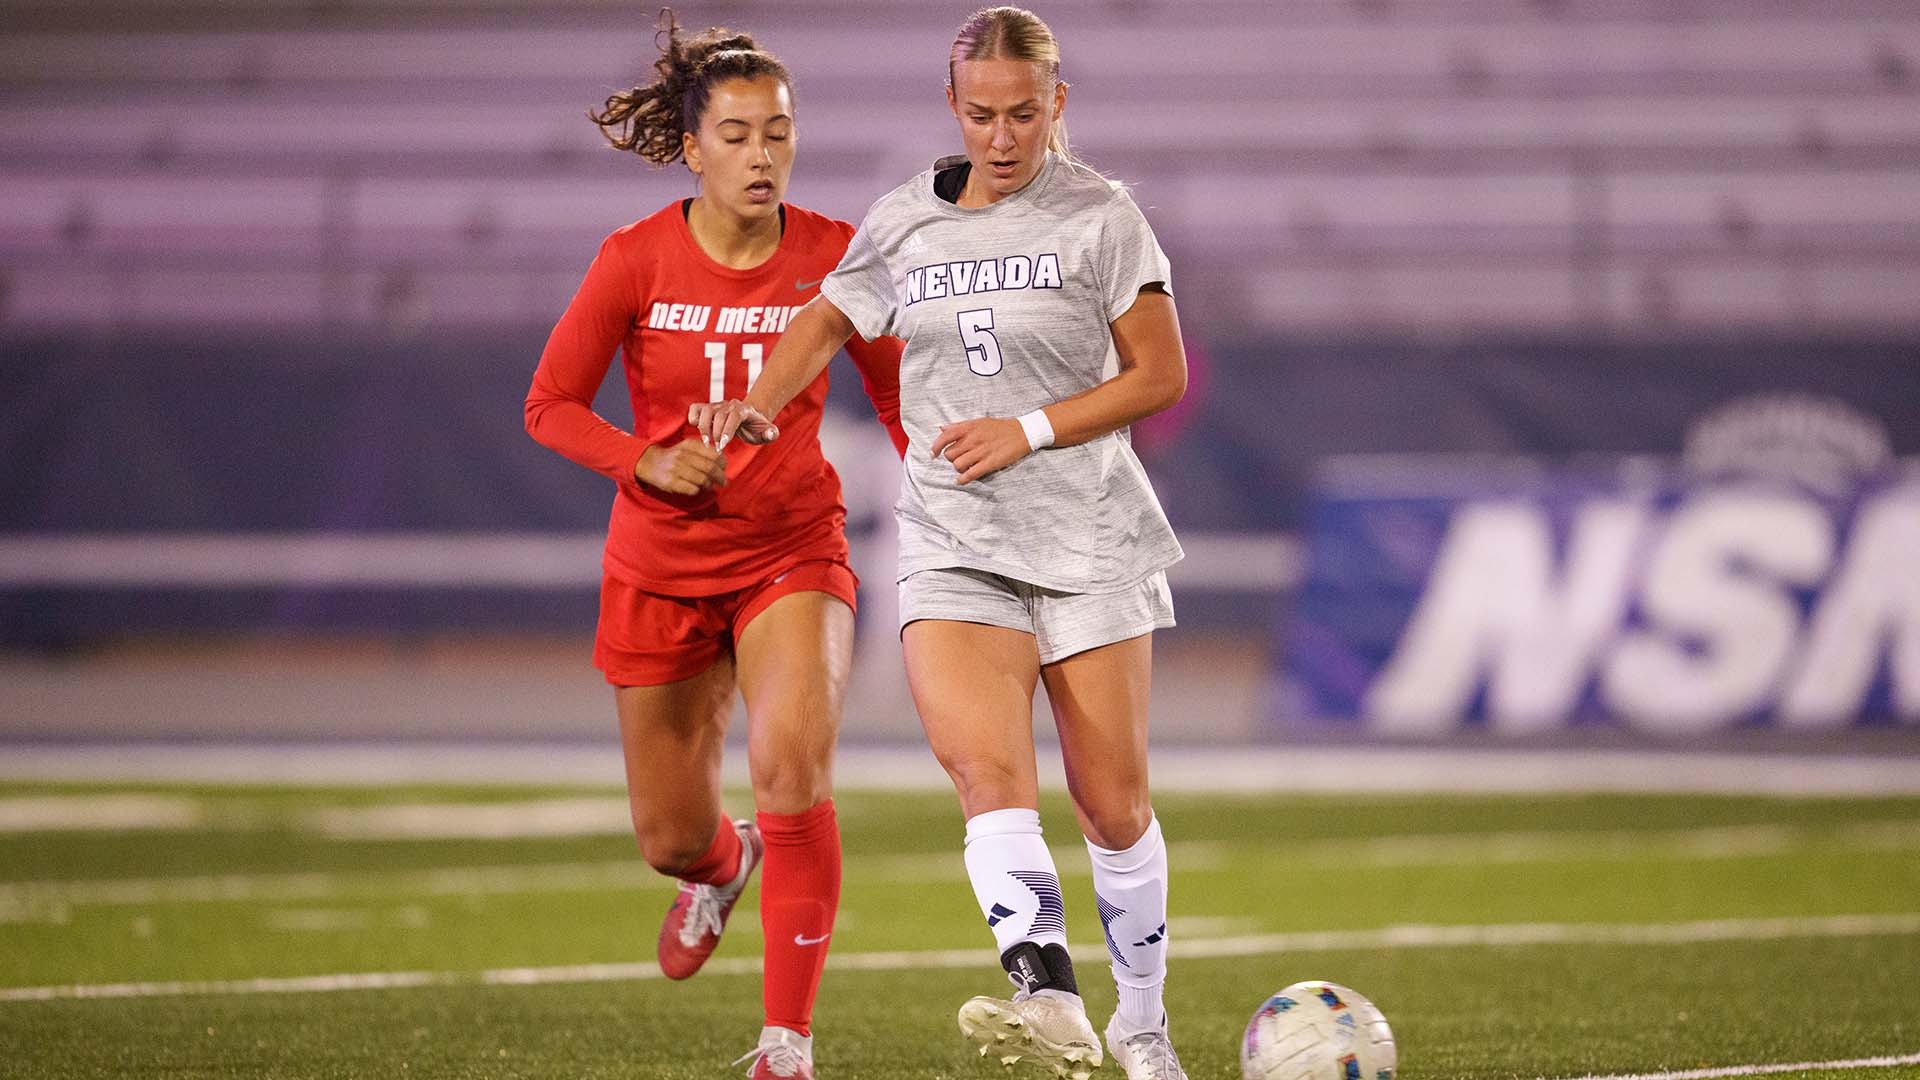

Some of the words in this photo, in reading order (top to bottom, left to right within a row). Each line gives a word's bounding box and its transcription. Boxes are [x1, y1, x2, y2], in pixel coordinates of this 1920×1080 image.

[905, 253, 1063, 307] NEVADA
[648, 302, 711, 332] NEW
[715, 306, 803, 334] MEXI
[957, 308, 1003, 377] 5
[704, 342, 764, 404] 11
